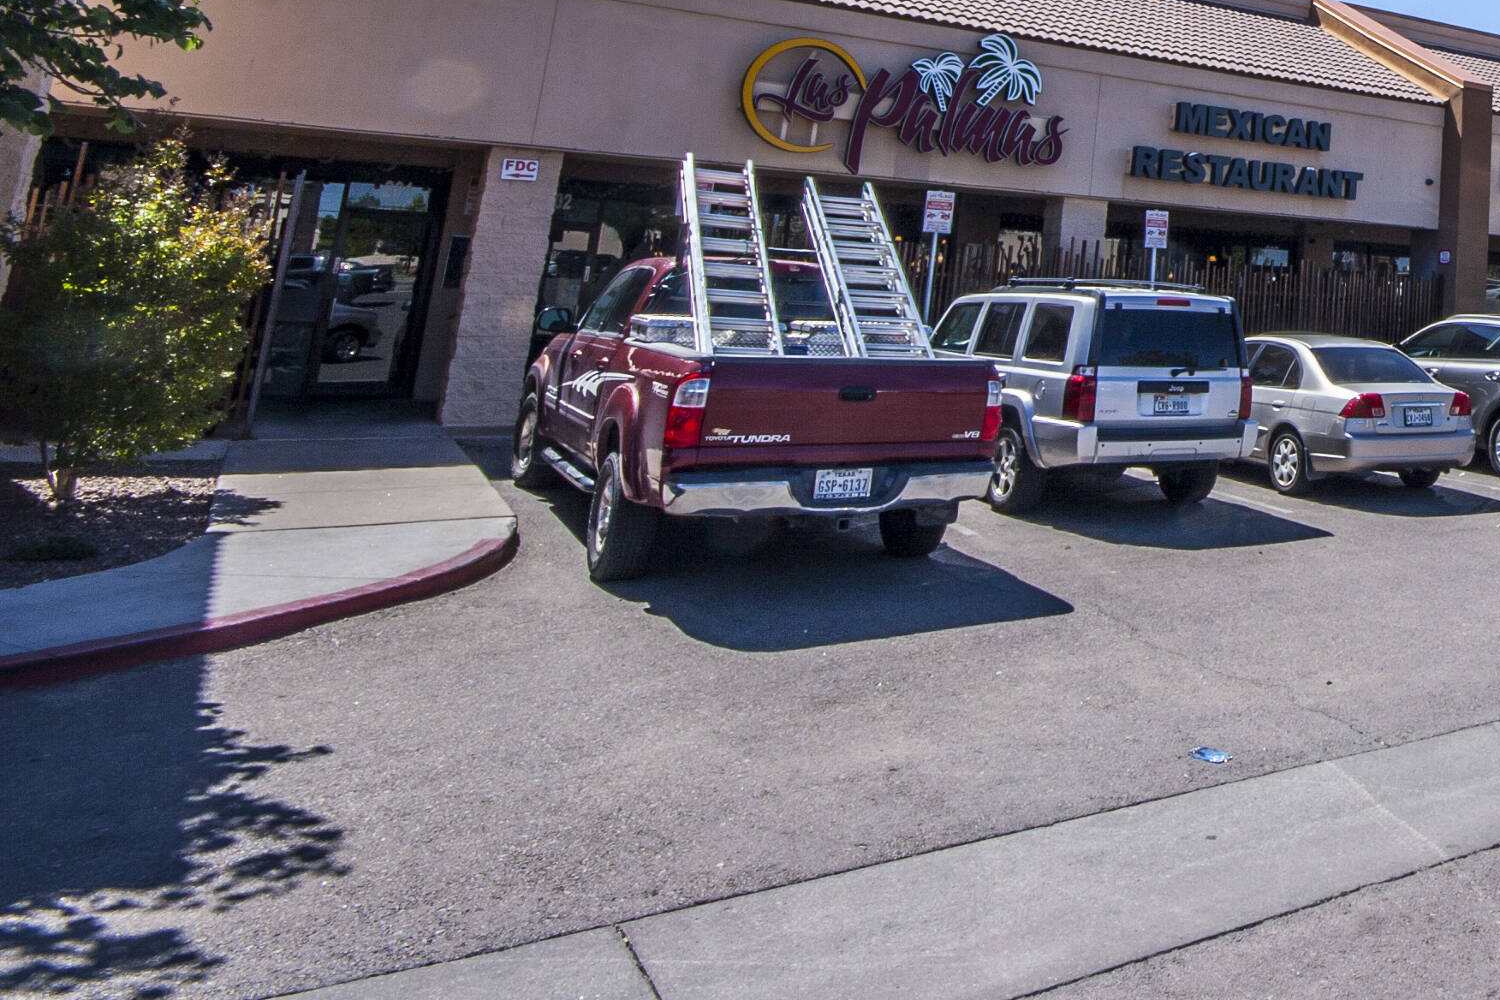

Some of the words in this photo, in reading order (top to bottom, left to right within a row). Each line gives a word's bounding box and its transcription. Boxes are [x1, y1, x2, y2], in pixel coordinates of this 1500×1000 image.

[754, 57, 851, 124] Las
[845, 66, 1070, 176] Palmas
[1175, 102, 1332, 151] MEXICAN
[505, 160, 537, 172] FDC
[1131, 145, 1364, 200] RESTAURANT
[731, 434, 791, 443] TUNDRA
[964, 430, 980, 438] V8
